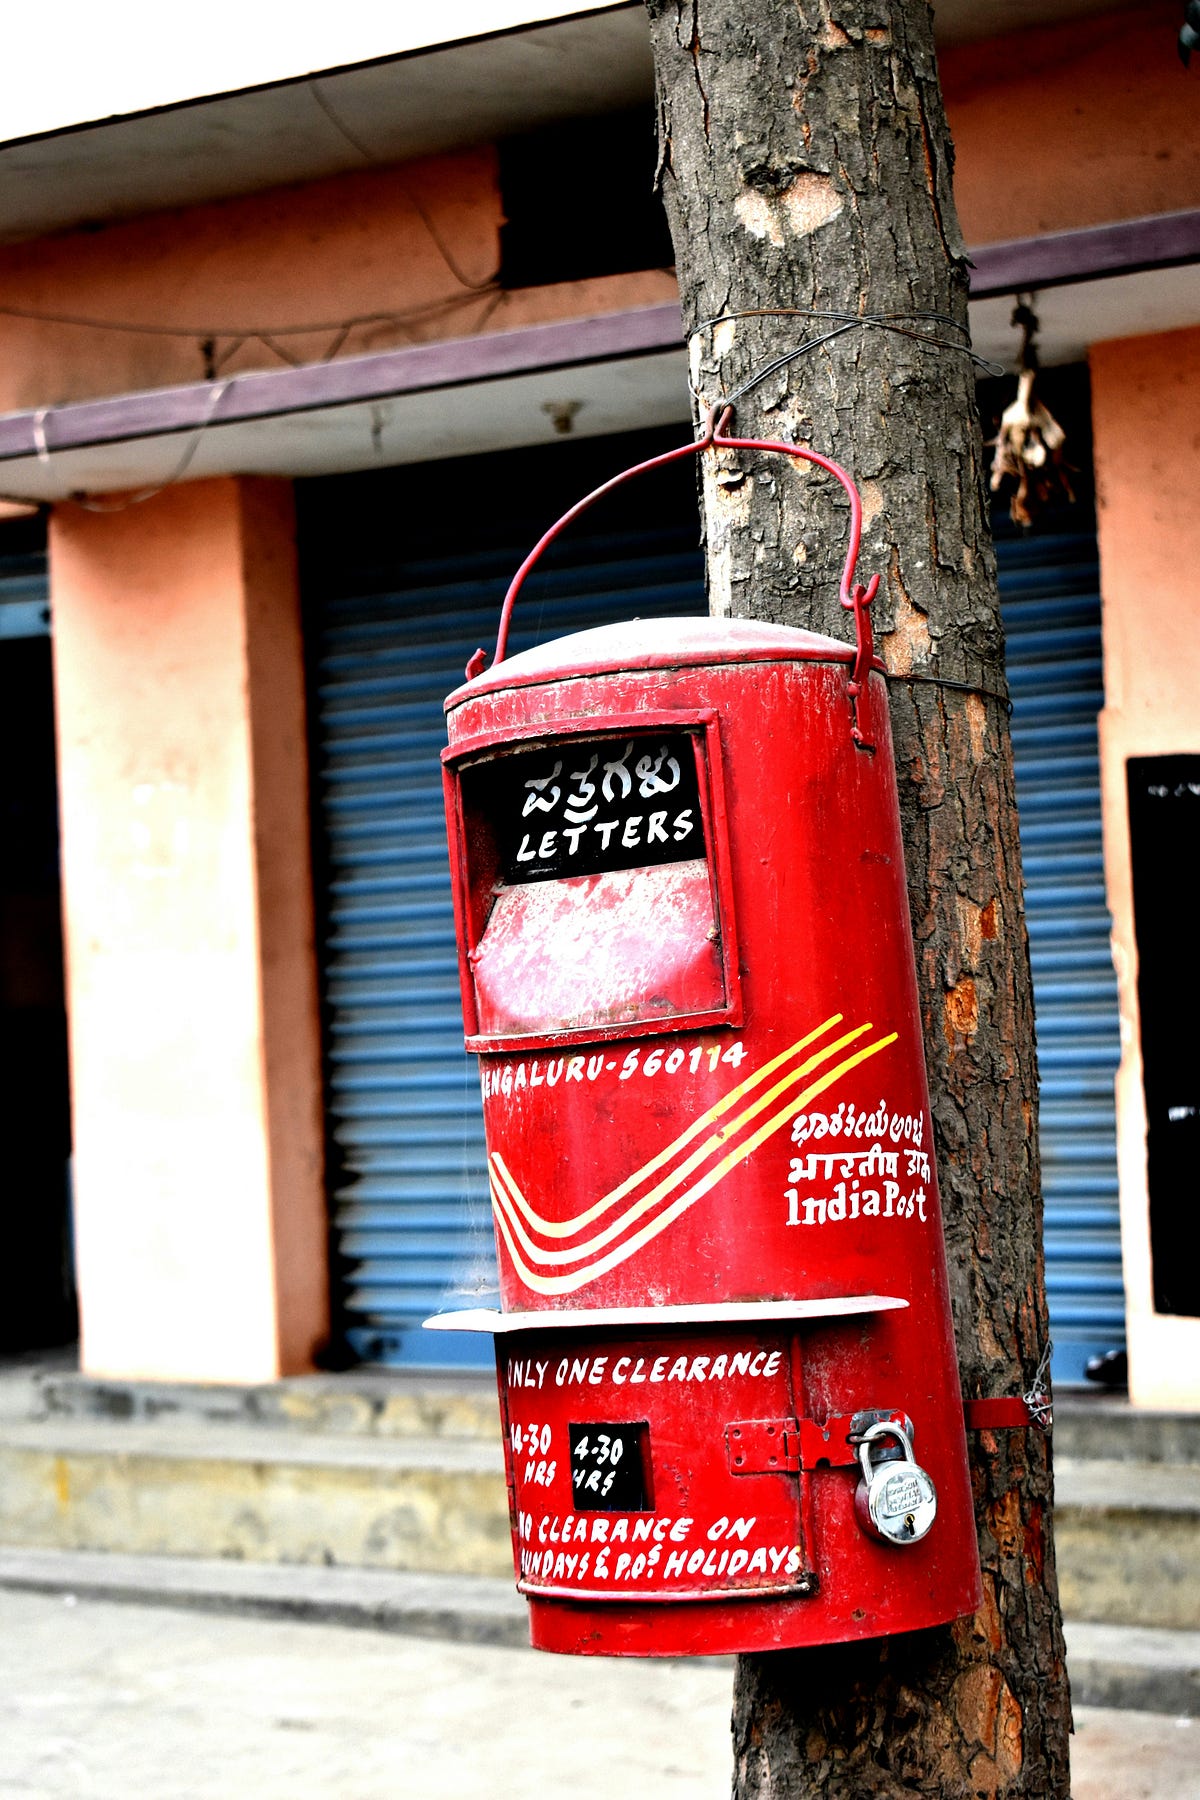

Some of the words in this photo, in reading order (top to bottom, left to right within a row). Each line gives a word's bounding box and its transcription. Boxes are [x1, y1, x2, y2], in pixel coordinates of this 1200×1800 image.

[516, 809, 694, 862] LETTERS
[787, 1142, 900, 1184] भारतीय
[903, 1148, 931, 1184] डाक
[507, 1358, 550, 1390] ONLY
[555, 1356, 609, 1387] ONE
[611, 1350, 783, 1385] CLEARANCE
[573, 1434, 624, 1466] 4-30
[523, 1460, 557, 1488] HRS
[572, 1468, 617, 1497] HRS
[538, 1514, 694, 1543] CLEARANCE
[706, 1516, 757, 1542] ON
[662, 1545, 801, 1580] HOLIDAYS
